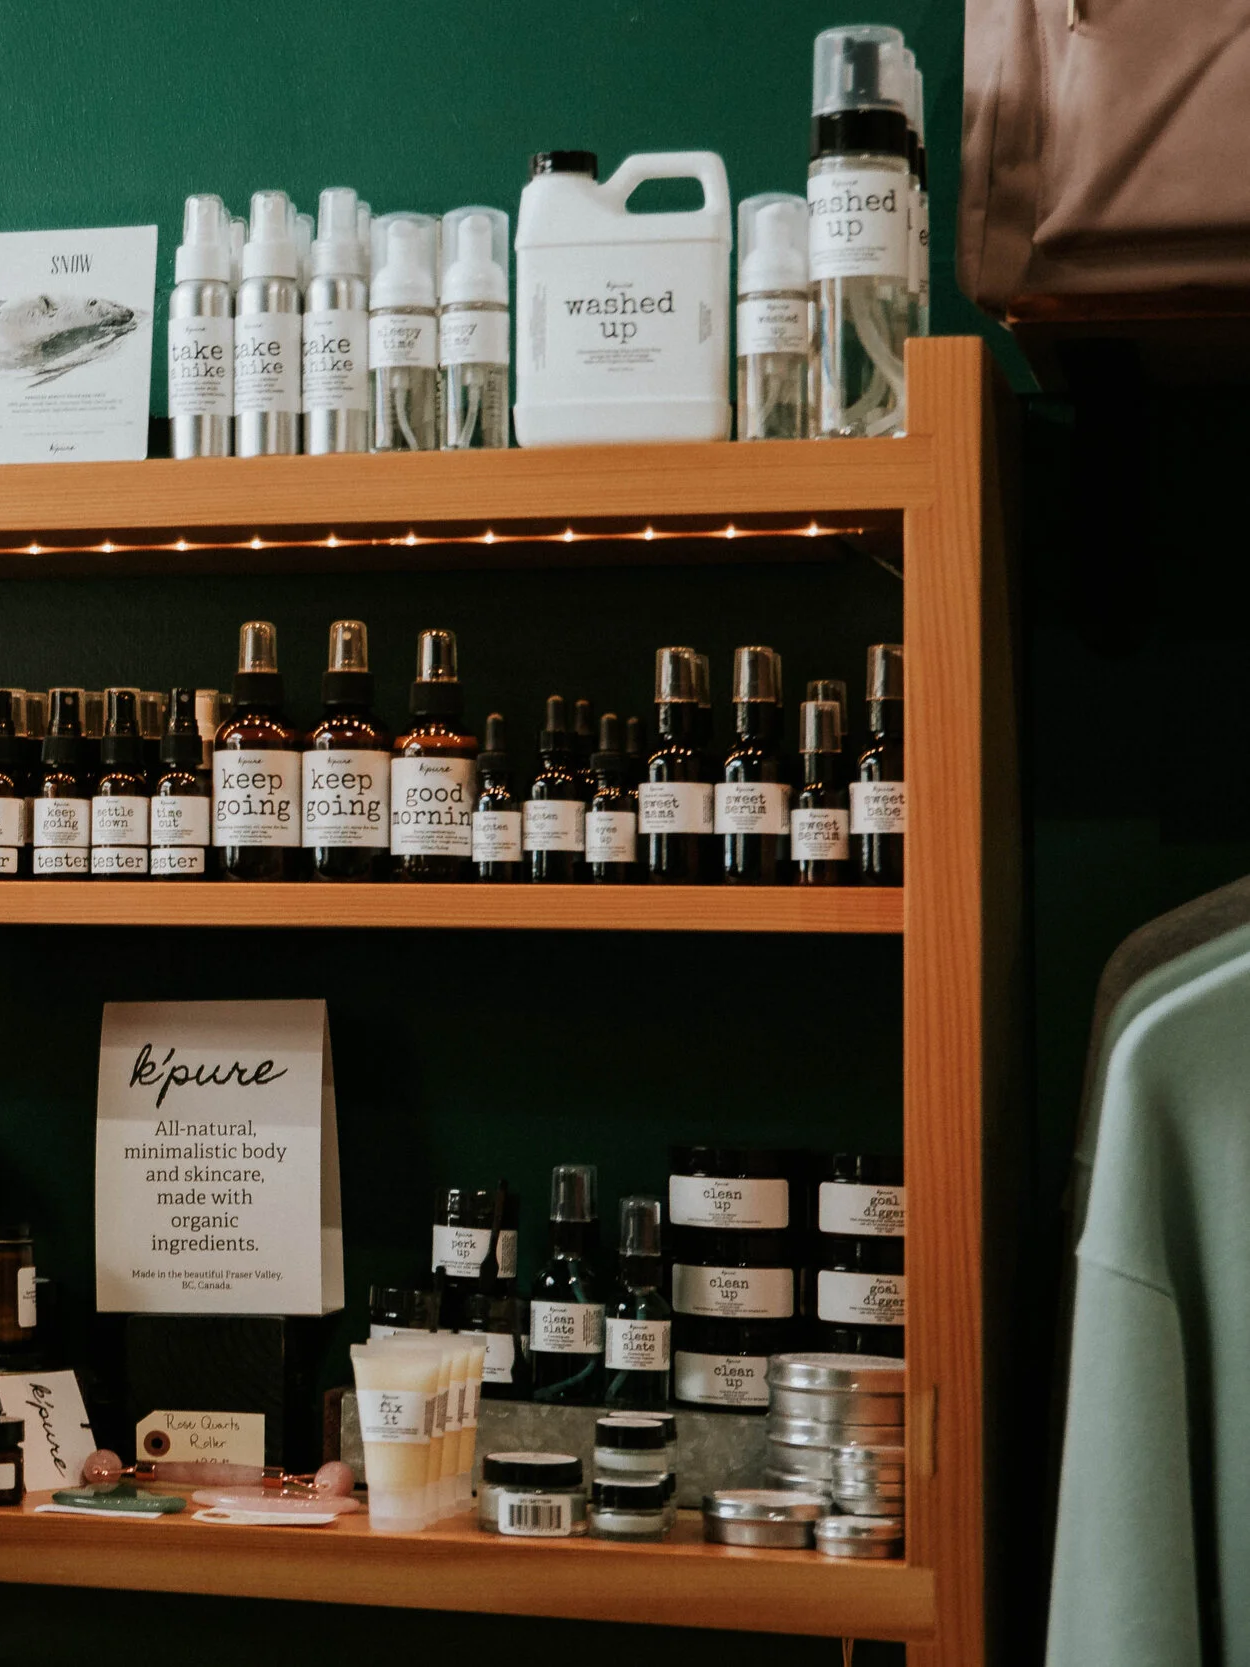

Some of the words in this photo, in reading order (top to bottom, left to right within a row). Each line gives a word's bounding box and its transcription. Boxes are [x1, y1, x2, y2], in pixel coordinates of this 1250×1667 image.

[827, 216, 863, 242] up
[50, 253, 94, 275] SNOW
[564, 291, 675, 316] washed
[600, 321, 638, 344] up
[172, 340, 224, 363] take
[180, 362, 226, 379] hike
[238, 358, 285, 378] hike
[308, 356, 355, 376] hike
[221, 768, 283, 795] keep
[311, 769, 373, 796] keep
[405, 783, 463, 807] good
[725, 794, 766, 805] sweet
[863, 794, 905, 806] sweet
[216, 795, 291, 822] going
[306, 795, 381, 822] going
[643, 798, 680, 809] sweet
[725, 805, 767, 815] serum
[47, 807, 76, 819] keep
[97, 806, 134, 818] settle
[156, 807, 183, 819] time
[866, 806, 902, 818] babe
[43, 817, 79, 831] going
[99, 818, 129, 828] down
[158, 818, 179, 828] out
[799, 820, 841, 831] sweet
[797, 831, 841, 842] serum
[38, 853, 89, 869] tester
[93, 853, 144, 868] tester
[128, 1042, 289, 1110] k'pure
[154, 1120, 257, 1139] All-natural,
[124, 1142, 238, 1160] minimalistic
[241, 1142, 287, 1163] body
[145, 1166, 179, 1183] and
[184, 1166, 266, 1185] skincare,
[157, 1189, 206, 1205] made
[211, 1188, 253, 1205] with
[703, 1187, 743, 1201] clean
[869, 1194, 900, 1208] goal
[713, 1200, 732, 1212] up
[863, 1206, 905, 1220] digger
[170, 1211, 239, 1232] organic
[151, 1235, 259, 1255] ingredients.
[451, 1239, 477, 1250] perk
[456, 1249, 470, 1259] up
[132, 1269, 156, 1279] Made
[157, 1269, 166, 1279] in
[168, 1269, 182, 1279] the
[184, 1269, 224, 1279] beautiful
[225, 1270, 253, 1279] Fraser
[709, 1276, 750, 1290] clean
[720, 1290, 738, 1302] up
[869, 1284, 900, 1297] goal
[863, 1295, 905, 1309] digger
[542, 1314, 575, 1325] clean
[543, 1324, 575, 1335] slate
[621, 1330, 656, 1341] clean
[622, 1340, 655, 1352] slate
[713, 1364, 755, 1378] clean
[724, 1377, 744, 1390] up
[379, 1400, 403, 1414] fix
[164, 1413, 197, 1431] Rose
[383, 1415, 399, 1425] it
[189, 1432, 228, 1450] Roller
